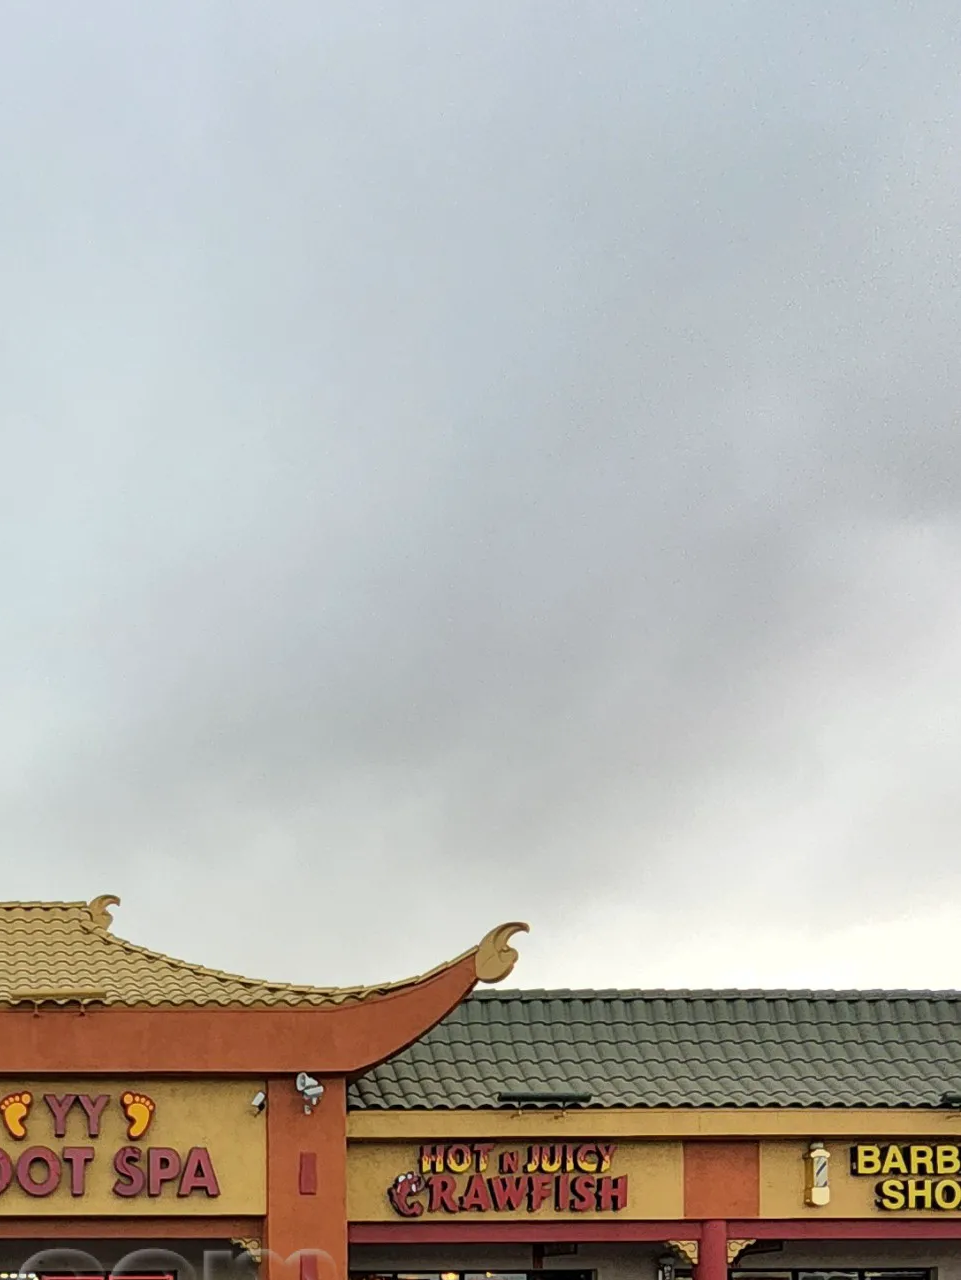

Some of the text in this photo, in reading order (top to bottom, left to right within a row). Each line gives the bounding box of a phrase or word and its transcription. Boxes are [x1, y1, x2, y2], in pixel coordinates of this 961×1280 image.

[44, 1094, 109, 1137] YY
[112, 1146, 220, 1198] SPA
[420, 1143, 494, 1173] HOT
[525, 1143, 618, 1173] JUICY
[388, 1172, 628, 1217] CRAWFISH
